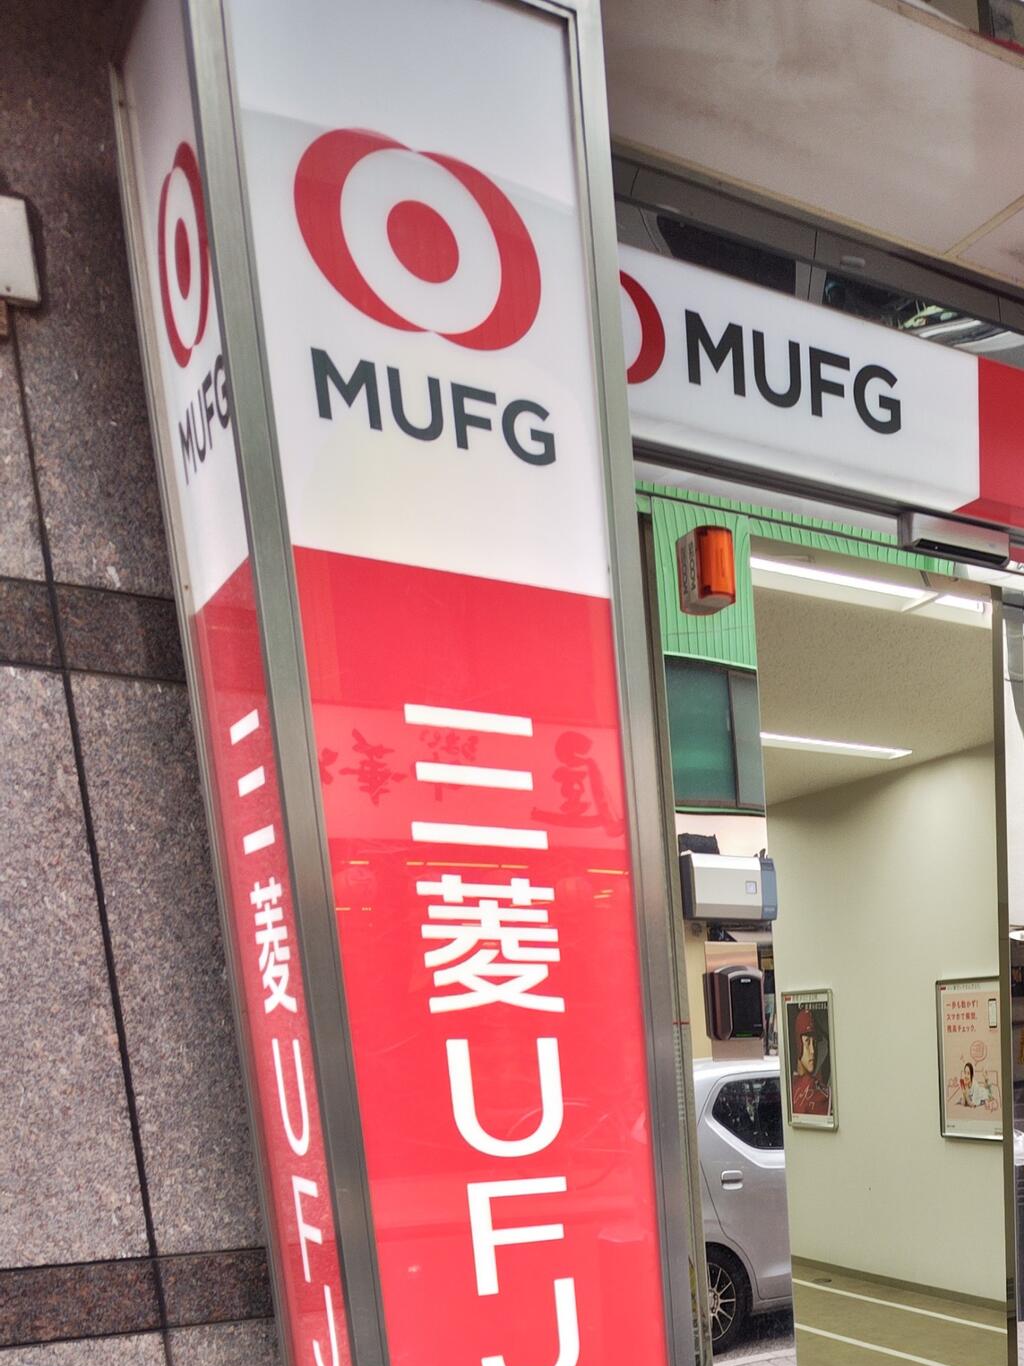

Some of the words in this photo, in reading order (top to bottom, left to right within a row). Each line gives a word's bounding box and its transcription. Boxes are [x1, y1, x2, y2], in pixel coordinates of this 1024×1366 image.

[178, 354, 232, 486] MUFG
[310, 347, 557, 467] MUFG
[685, 308, 902, 435] MUFG
